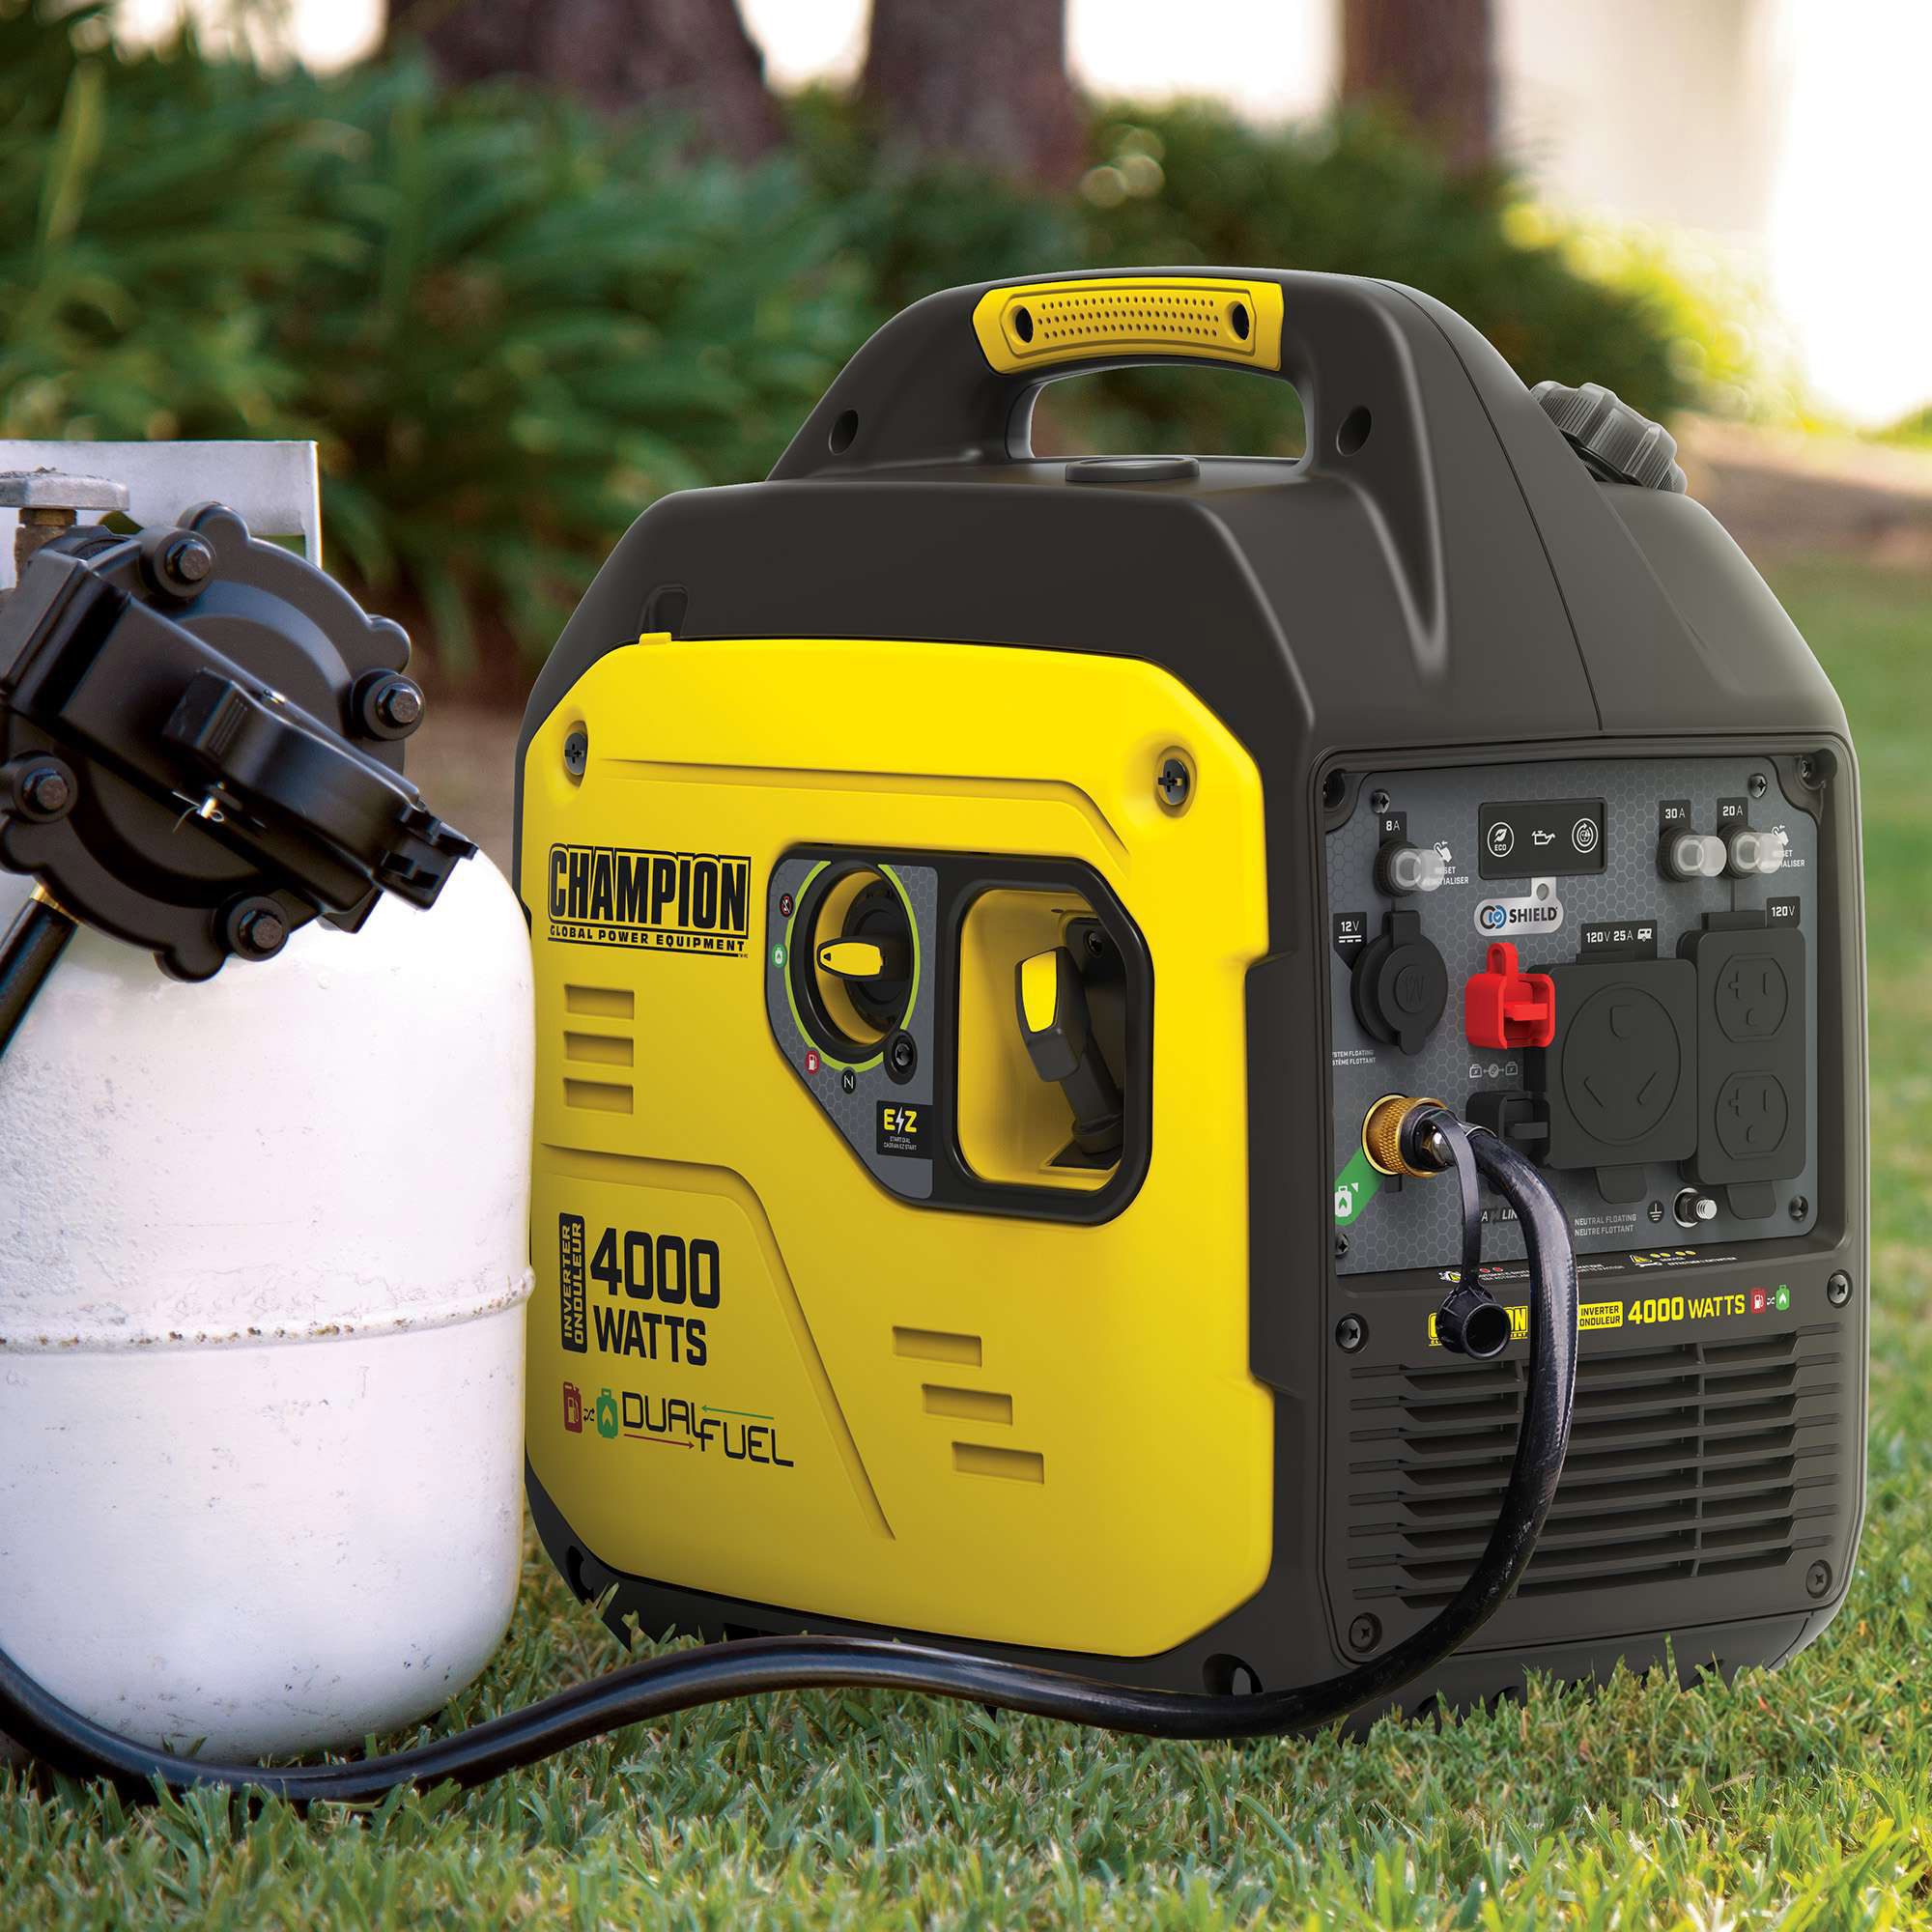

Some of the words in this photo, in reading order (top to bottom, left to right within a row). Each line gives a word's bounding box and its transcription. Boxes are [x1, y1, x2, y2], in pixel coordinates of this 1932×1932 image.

[549, 845, 749, 935] CHAMPION
[1509, 906, 1557, 923] SHIELD
[1771, 905, 1796, 918] 120V
[1340, 921, 1360, 932] 12V
[550, 925, 593, 941] GLOBAL
[598, 930, 649, 945] POWER
[656, 934, 745, 952] EQUIPMENT
[1585, 930, 1611, 943] 120V
[1613, 929, 1634, 942] 25A
[1576, 1217, 1605, 1226] NEUTRAL
[1605, 1213, 1637, 1223] FLOATING
[1576, 1227, 1601, 1236] NEUTRE
[1602, 1224, 1634, 1235] FLOTTANT
[590, 1228, 720, 1309] 4000
[562, 1225, 573, 1338] INVERTER
[572, 1222, 584, 1346] ONDULEUR
[1580, 1305, 1619, 1316] INVERTER
[1628, 1296, 1685, 1324] 4000
[1688, 1294, 1746, 1320] WATTS
[1579, 1315, 1621, 1327] ONDULEUR
[593, 1304, 707, 1366] WATTS
